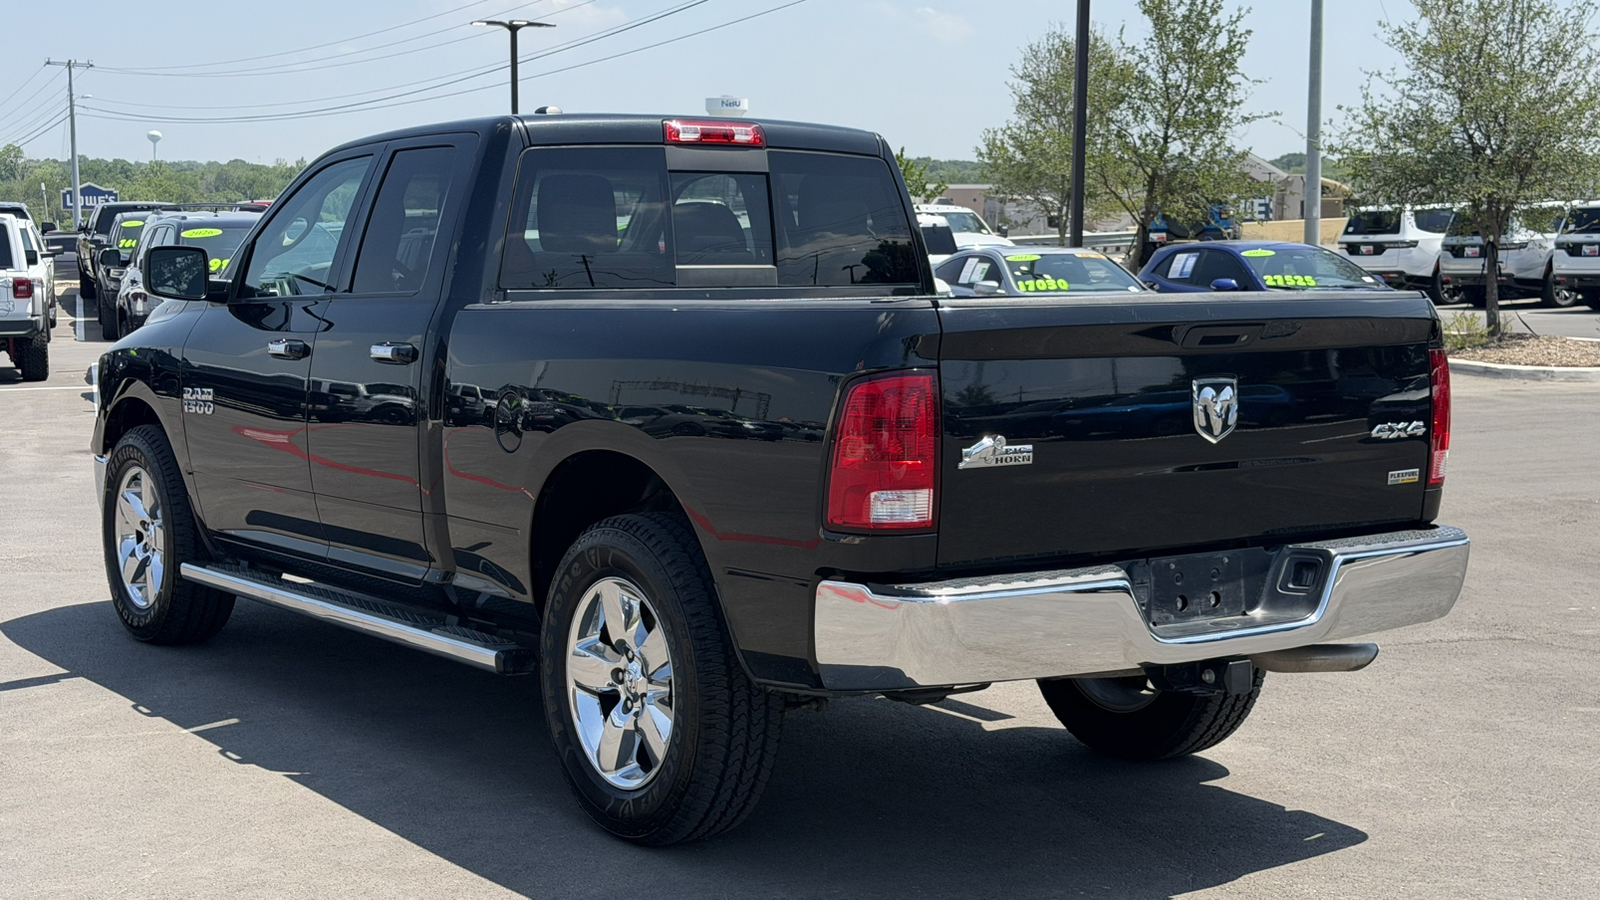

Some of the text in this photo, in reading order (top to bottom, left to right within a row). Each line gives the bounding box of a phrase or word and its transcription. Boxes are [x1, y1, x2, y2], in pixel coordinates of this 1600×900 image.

[1017, 279, 1068, 292] 17030
[183, 387, 213, 400] RAM
[184, 401, 213, 415] 1500
[995, 455, 1030, 464] HORN
